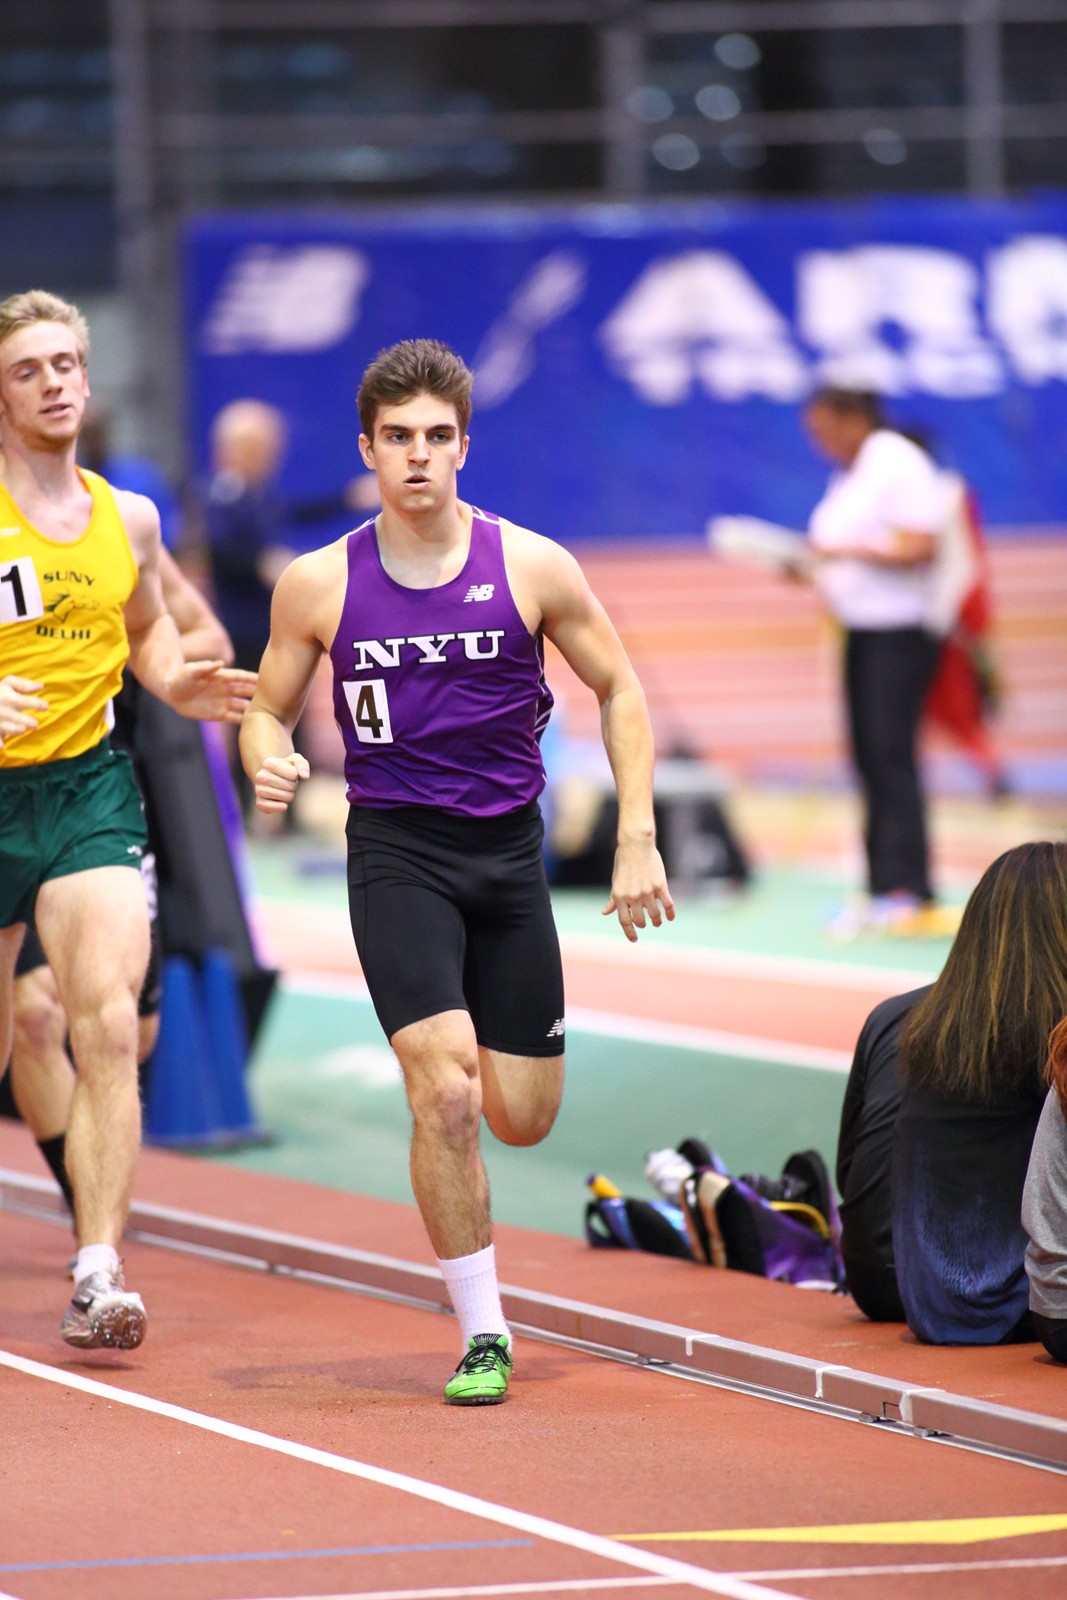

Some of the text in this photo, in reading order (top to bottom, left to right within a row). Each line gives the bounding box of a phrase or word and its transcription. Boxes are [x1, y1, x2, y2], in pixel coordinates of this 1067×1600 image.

[0, 565, 27, 617] 1
[43, 571, 95, 586] SUNY
[36, 625, 91, 640] DELHI
[353, 630, 505, 670] NYU
[355, 685, 384, 739] 4
